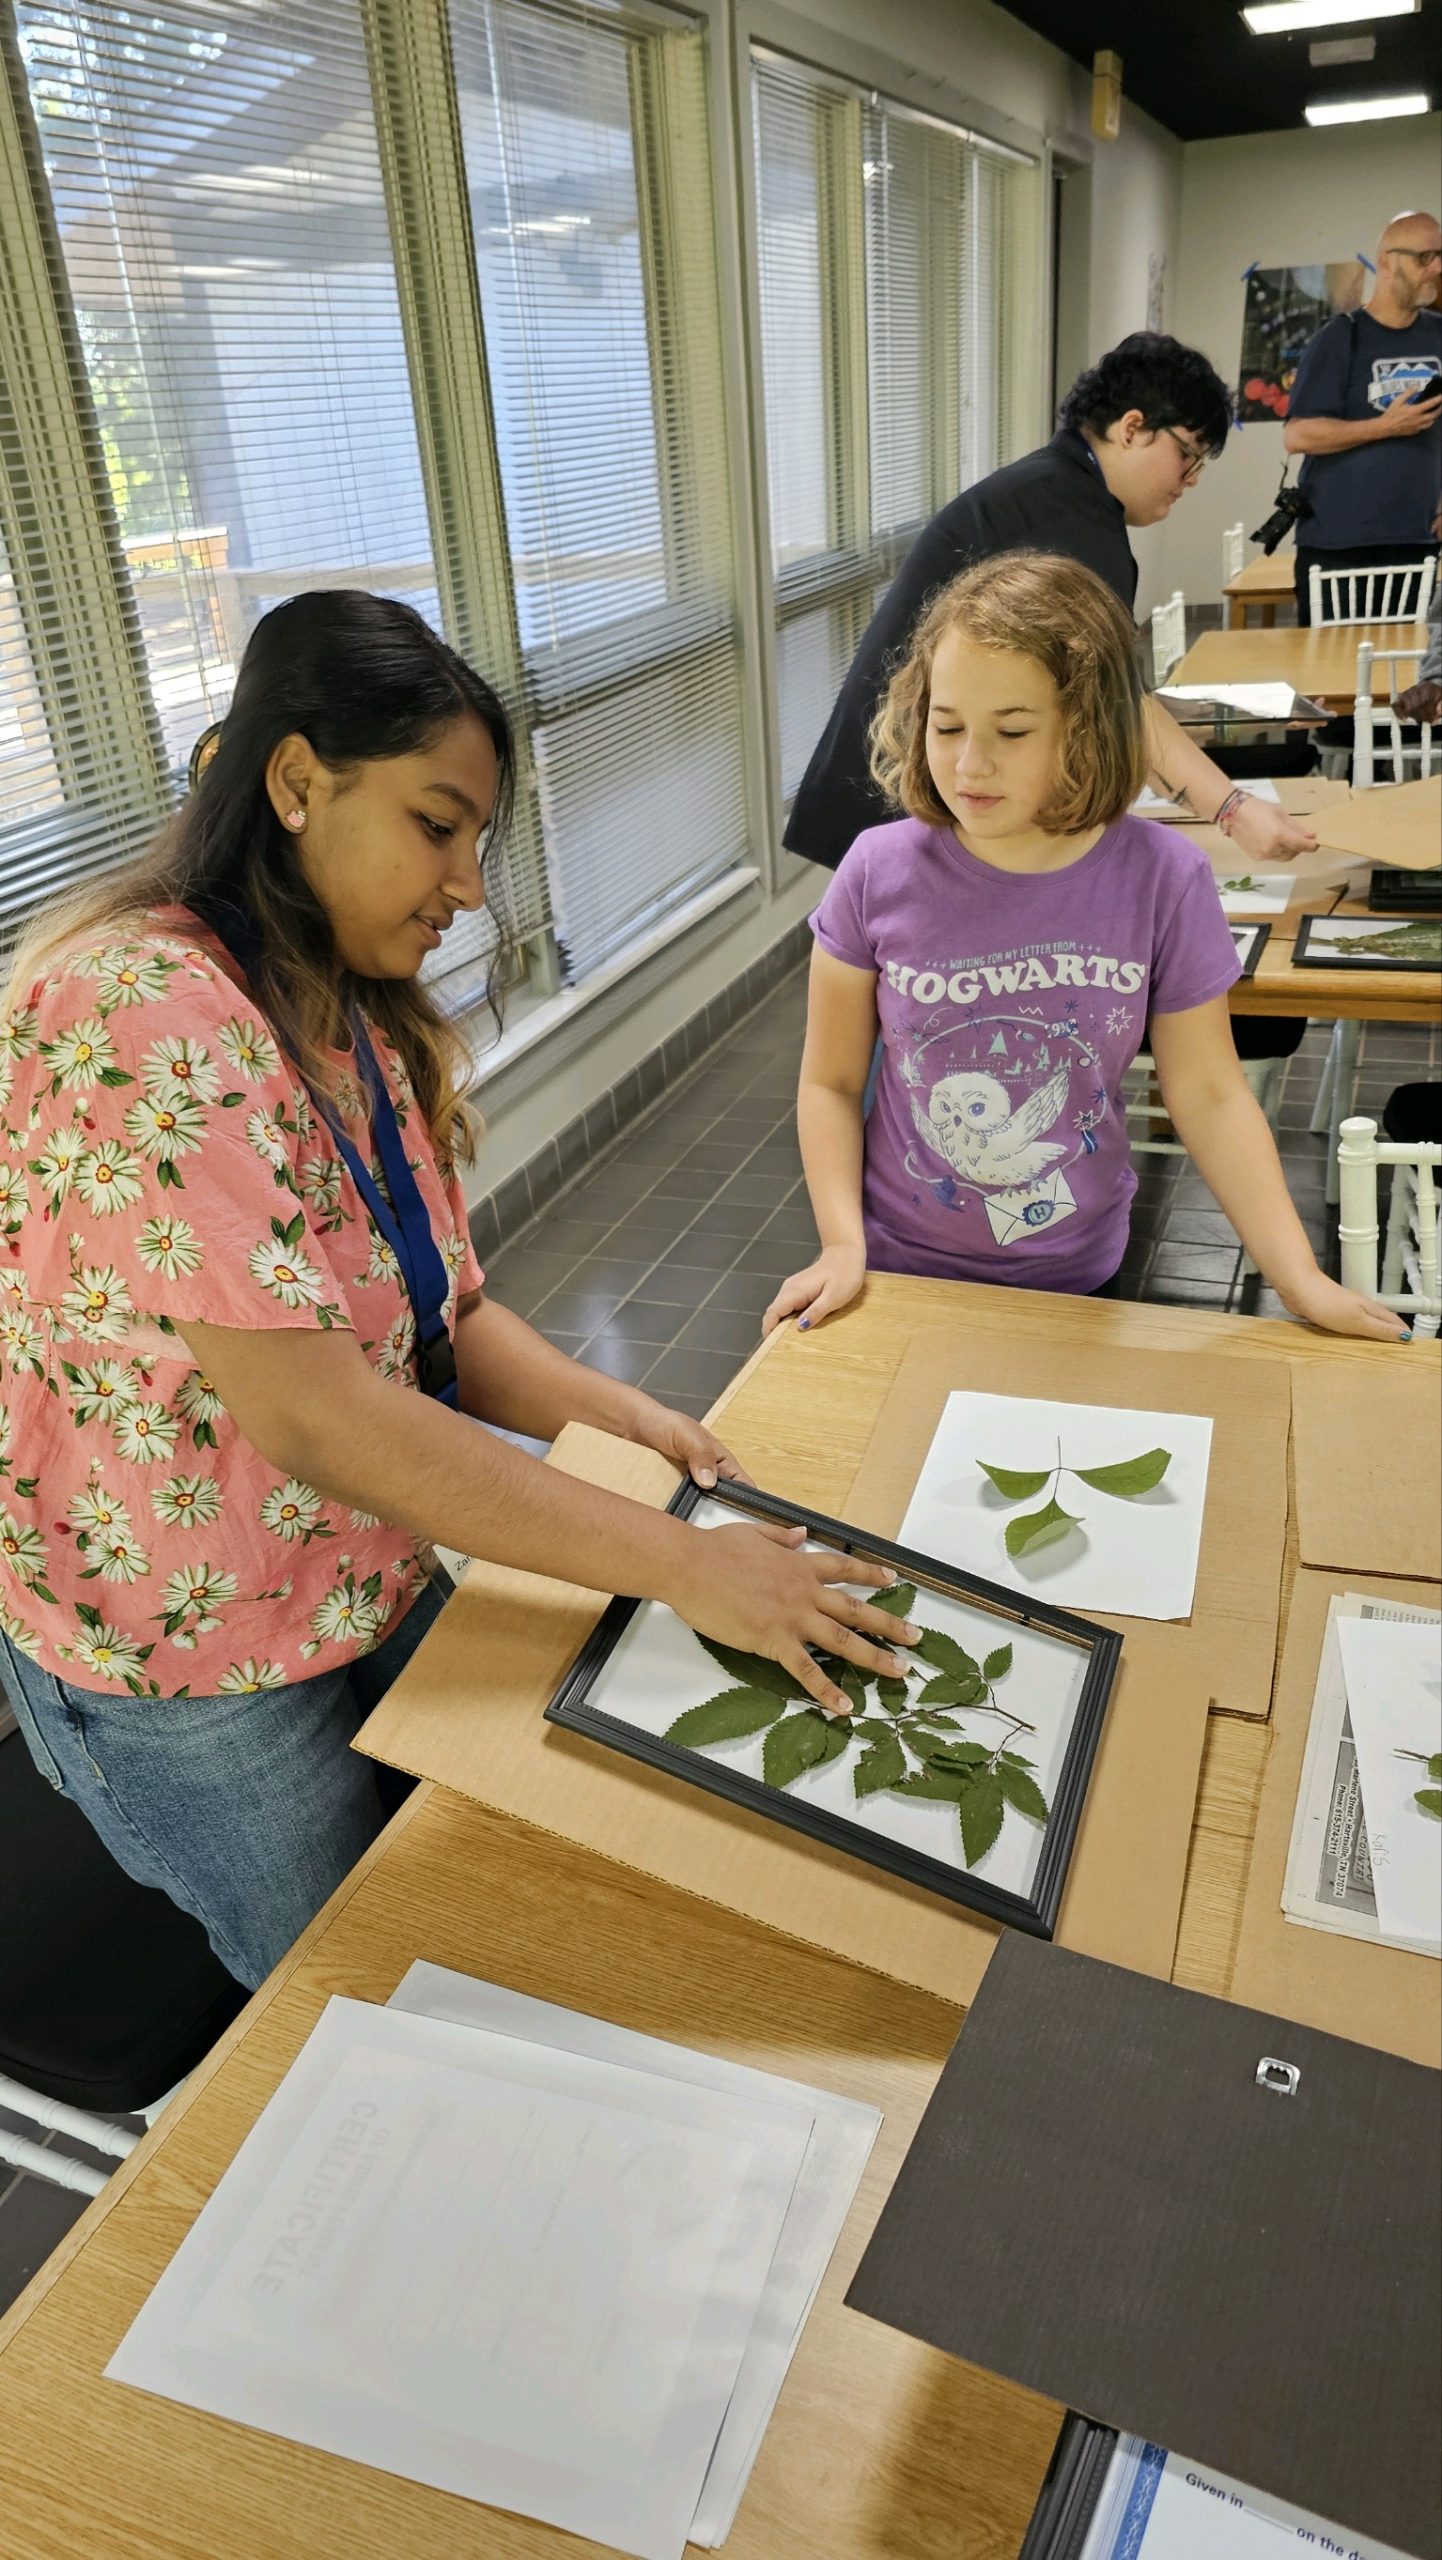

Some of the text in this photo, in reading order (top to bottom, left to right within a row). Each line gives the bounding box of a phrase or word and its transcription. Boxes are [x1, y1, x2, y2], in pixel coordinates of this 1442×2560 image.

[949, 940, 1077, 970] WAITING FOR MY LETTER FROM
[886, 953, 1146, 1004] HOGWARTS
[1033, 1206, 1047, 1220] H
[1329, 1784, 1347, 1855] Phone: 615-374-2111
[1347, 1796, 1357, 1817] Street
[1338, 1861, 1348, 1872] TN
[1335, 1873, 1346, 1896] 37074
[1185, 2472, 1227, 2501] Given
[1229, 2493, 1244, 2509] in
[1296, 2527, 1316, 2543] on
[1319, 2536, 1345, 2557] the
